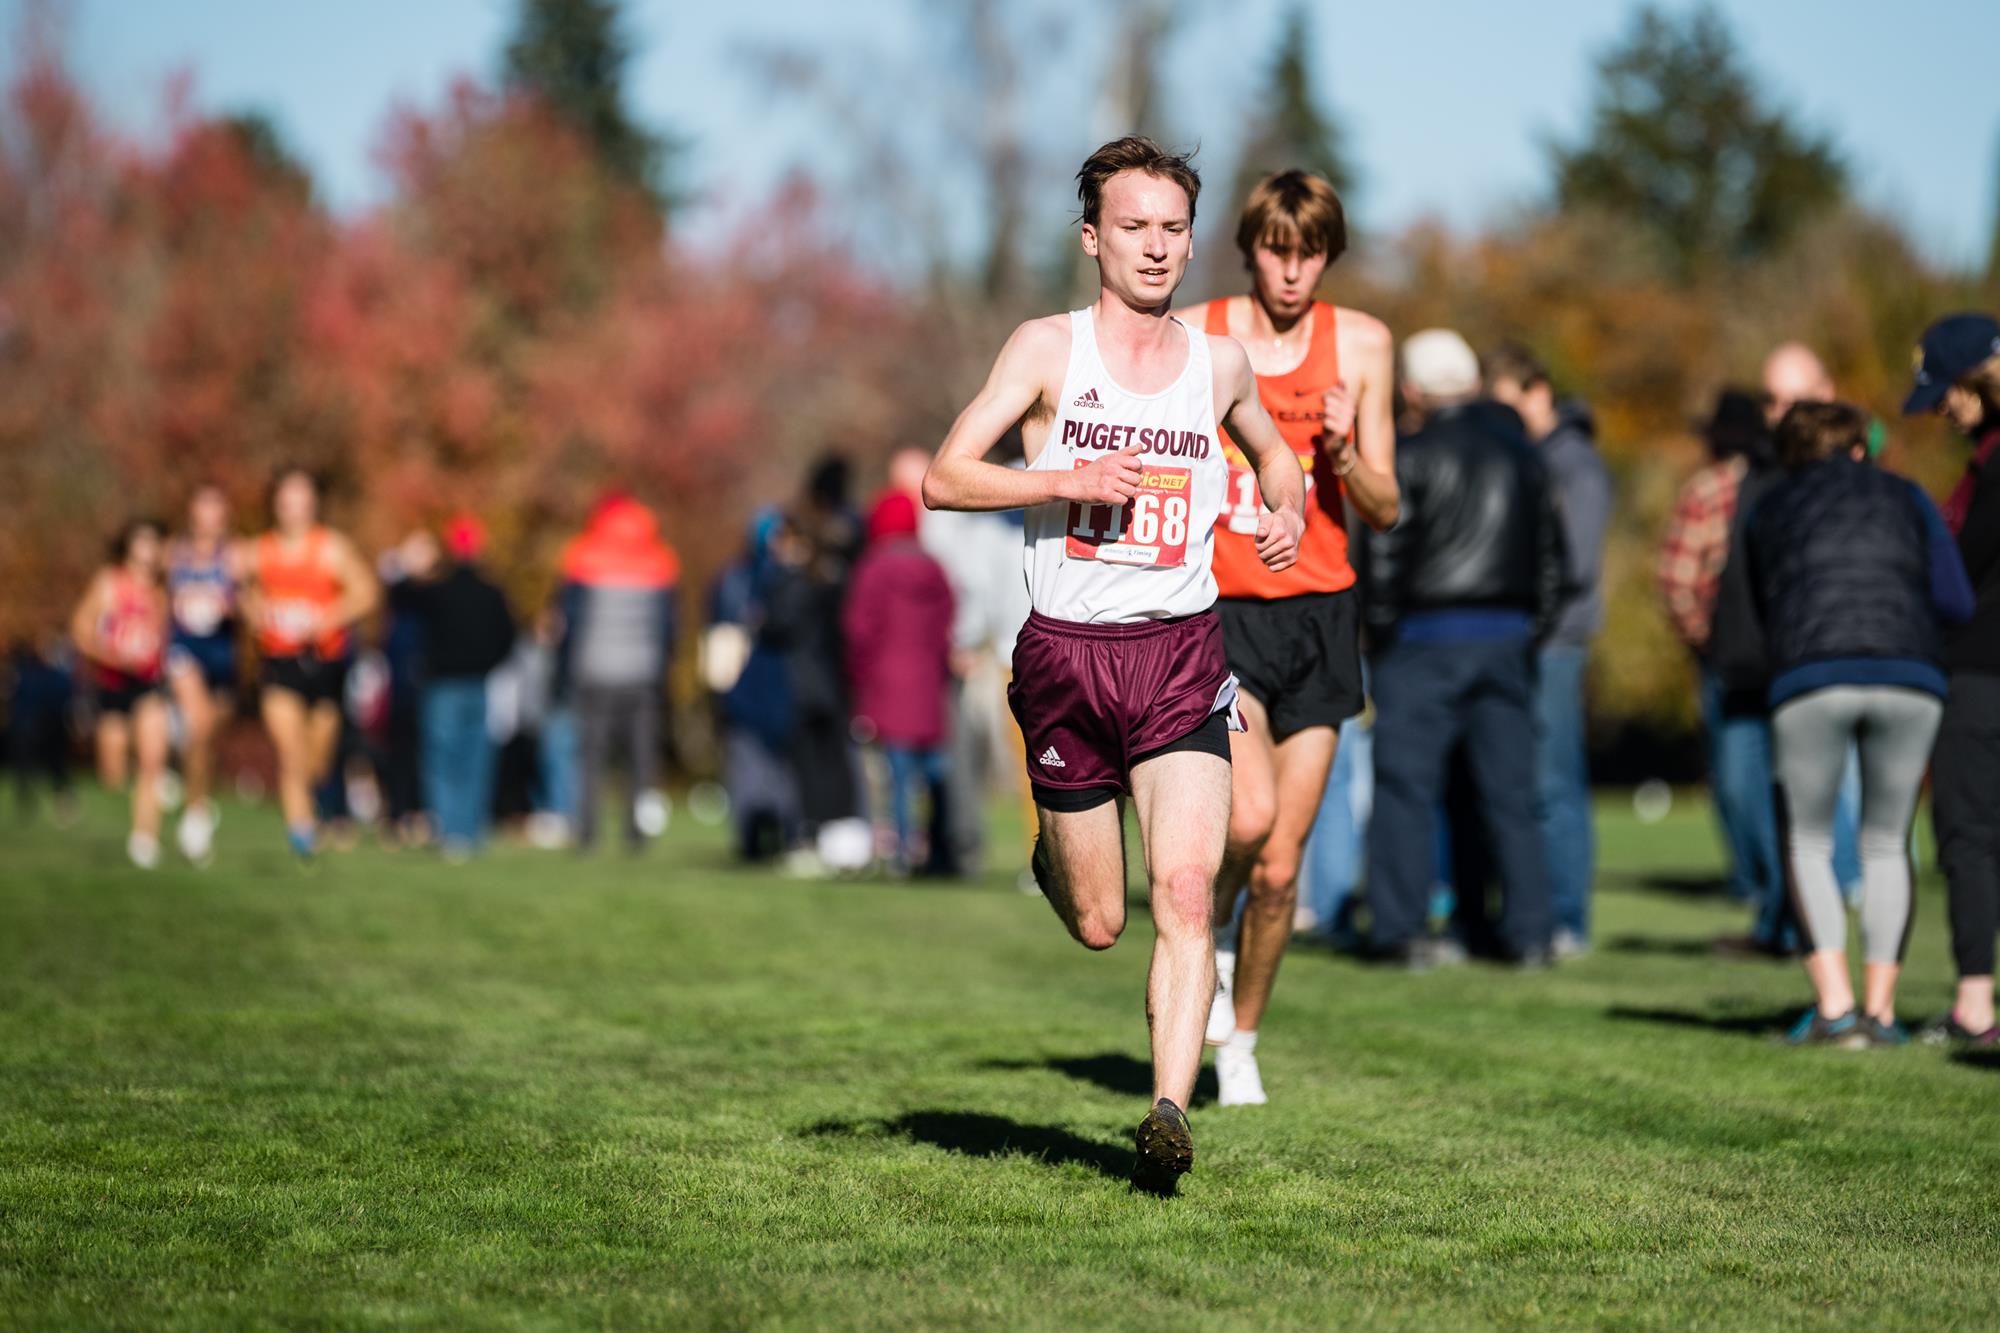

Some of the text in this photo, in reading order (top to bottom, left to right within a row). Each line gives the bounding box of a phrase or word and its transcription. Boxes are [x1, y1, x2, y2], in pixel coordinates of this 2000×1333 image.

[1073, 400, 1104, 409] adidas
[1061, 419, 1137, 451] PUGET
[1139, 428, 1209, 460] SOUND
[1071, 494, 1188, 547] 1168
[1040, 757, 1066, 767] adidas
